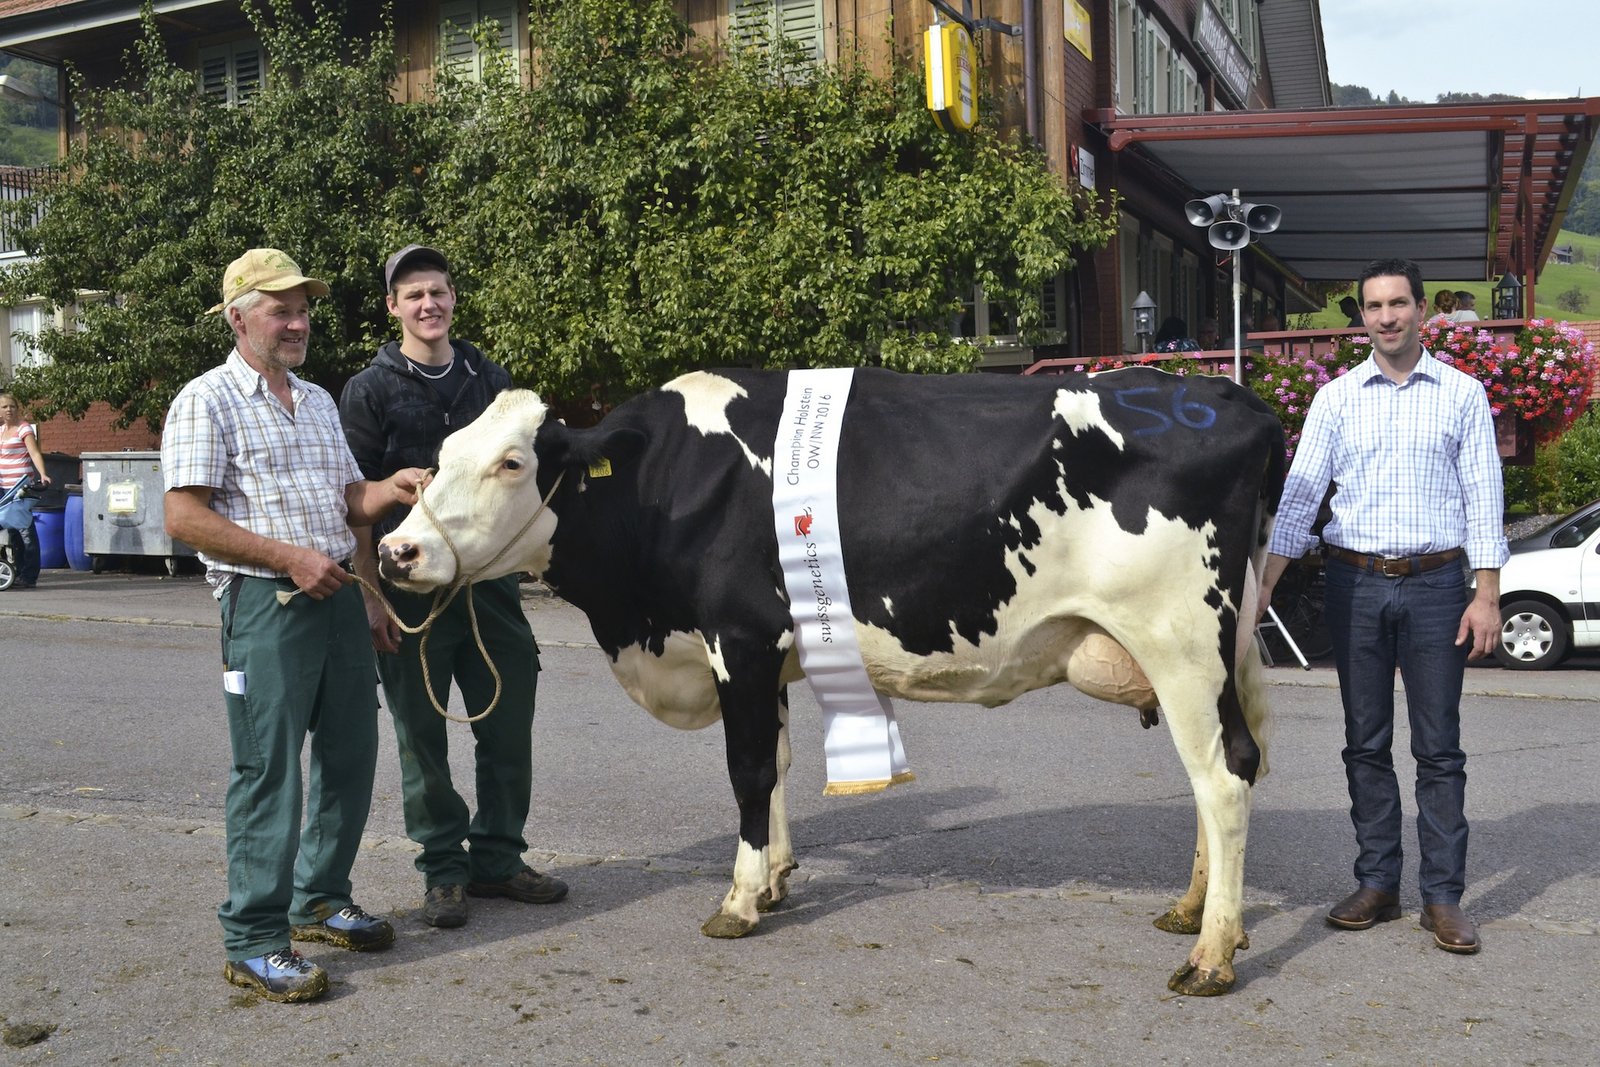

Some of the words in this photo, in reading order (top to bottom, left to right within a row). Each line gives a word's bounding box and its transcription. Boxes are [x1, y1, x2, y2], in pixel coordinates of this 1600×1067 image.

[794, 387, 813, 426] Holstein
[815, 394, 832, 419] 2016
[1114, 384, 1217, 436] 56
[787, 428, 804, 485] Champion
[807, 421, 825, 469] OW/NW
[804, 541, 832, 643] swissgenetics
